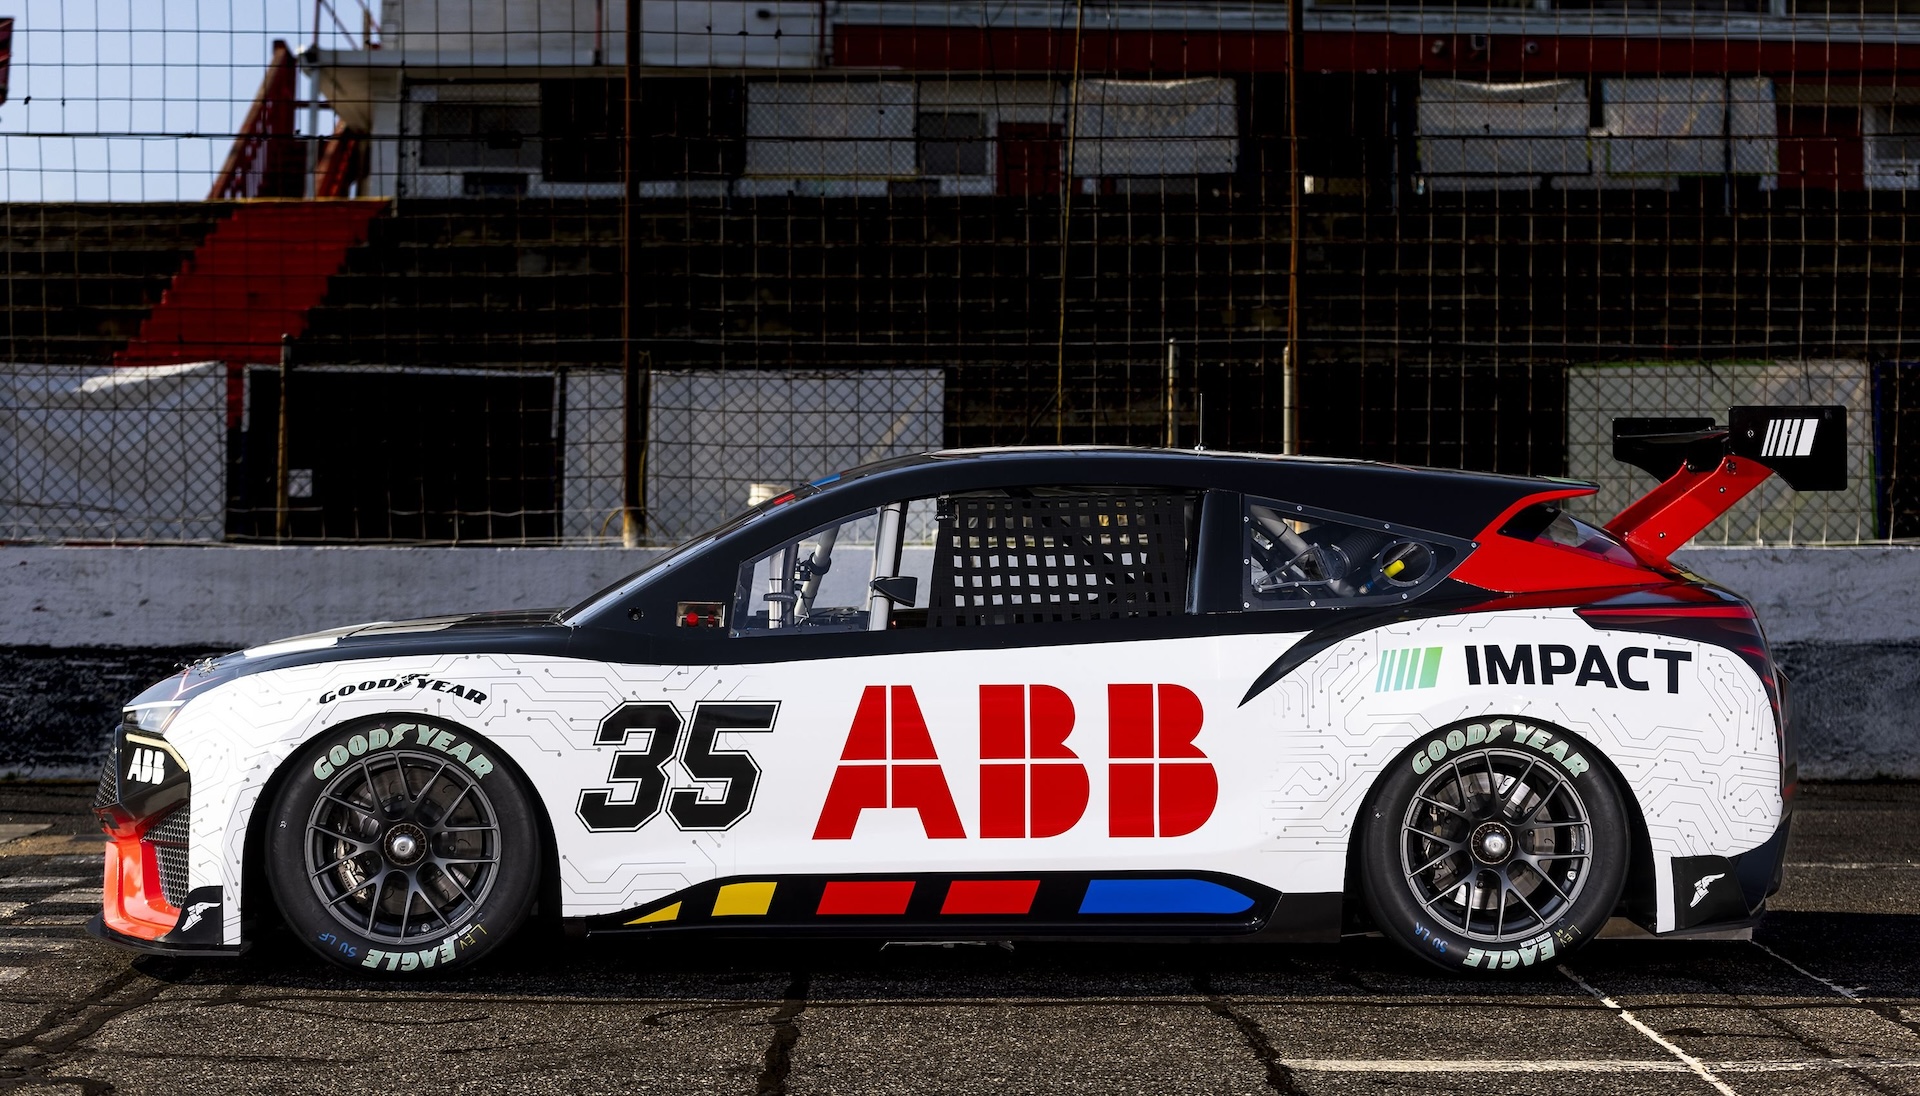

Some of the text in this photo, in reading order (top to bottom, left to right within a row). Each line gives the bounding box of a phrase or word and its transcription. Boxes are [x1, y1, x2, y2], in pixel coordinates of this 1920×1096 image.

[1464, 644, 1692, 695] IMPACT
[126, 747, 165, 786] ABB
[575, 699, 783, 835] 35
[812, 683, 1219, 840] ABB
[361, 936, 457, 971] EAGLE
[1462, 936, 1556, 970] EAGLE
